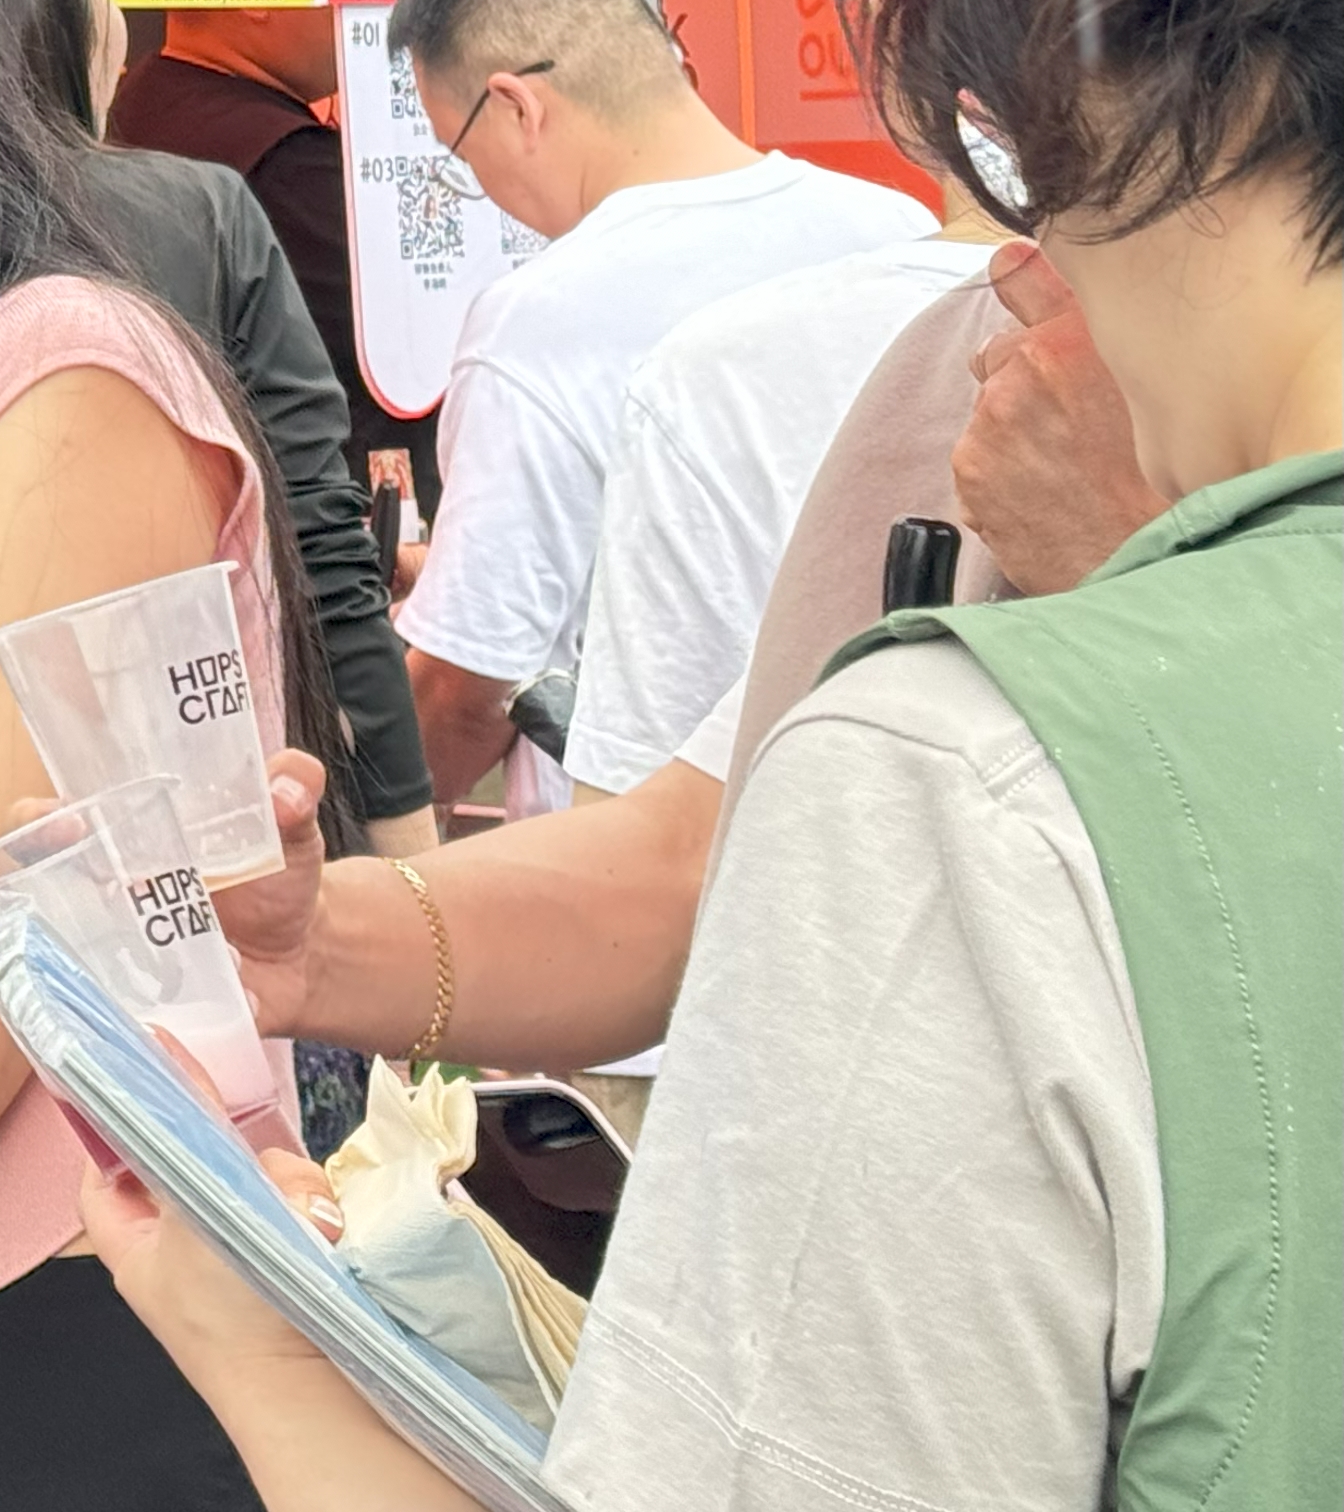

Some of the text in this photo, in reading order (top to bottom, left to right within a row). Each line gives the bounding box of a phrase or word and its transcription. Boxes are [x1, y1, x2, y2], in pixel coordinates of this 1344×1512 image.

[351, 21, 381, 48] #01
[359, 157, 395, 184] #03
[167, 649, 243, 696] HOPS
[178, 681, 251, 726] CRAF
[128, 867, 205, 917] HOPS
[144, 900, 218, 947] CRAF
